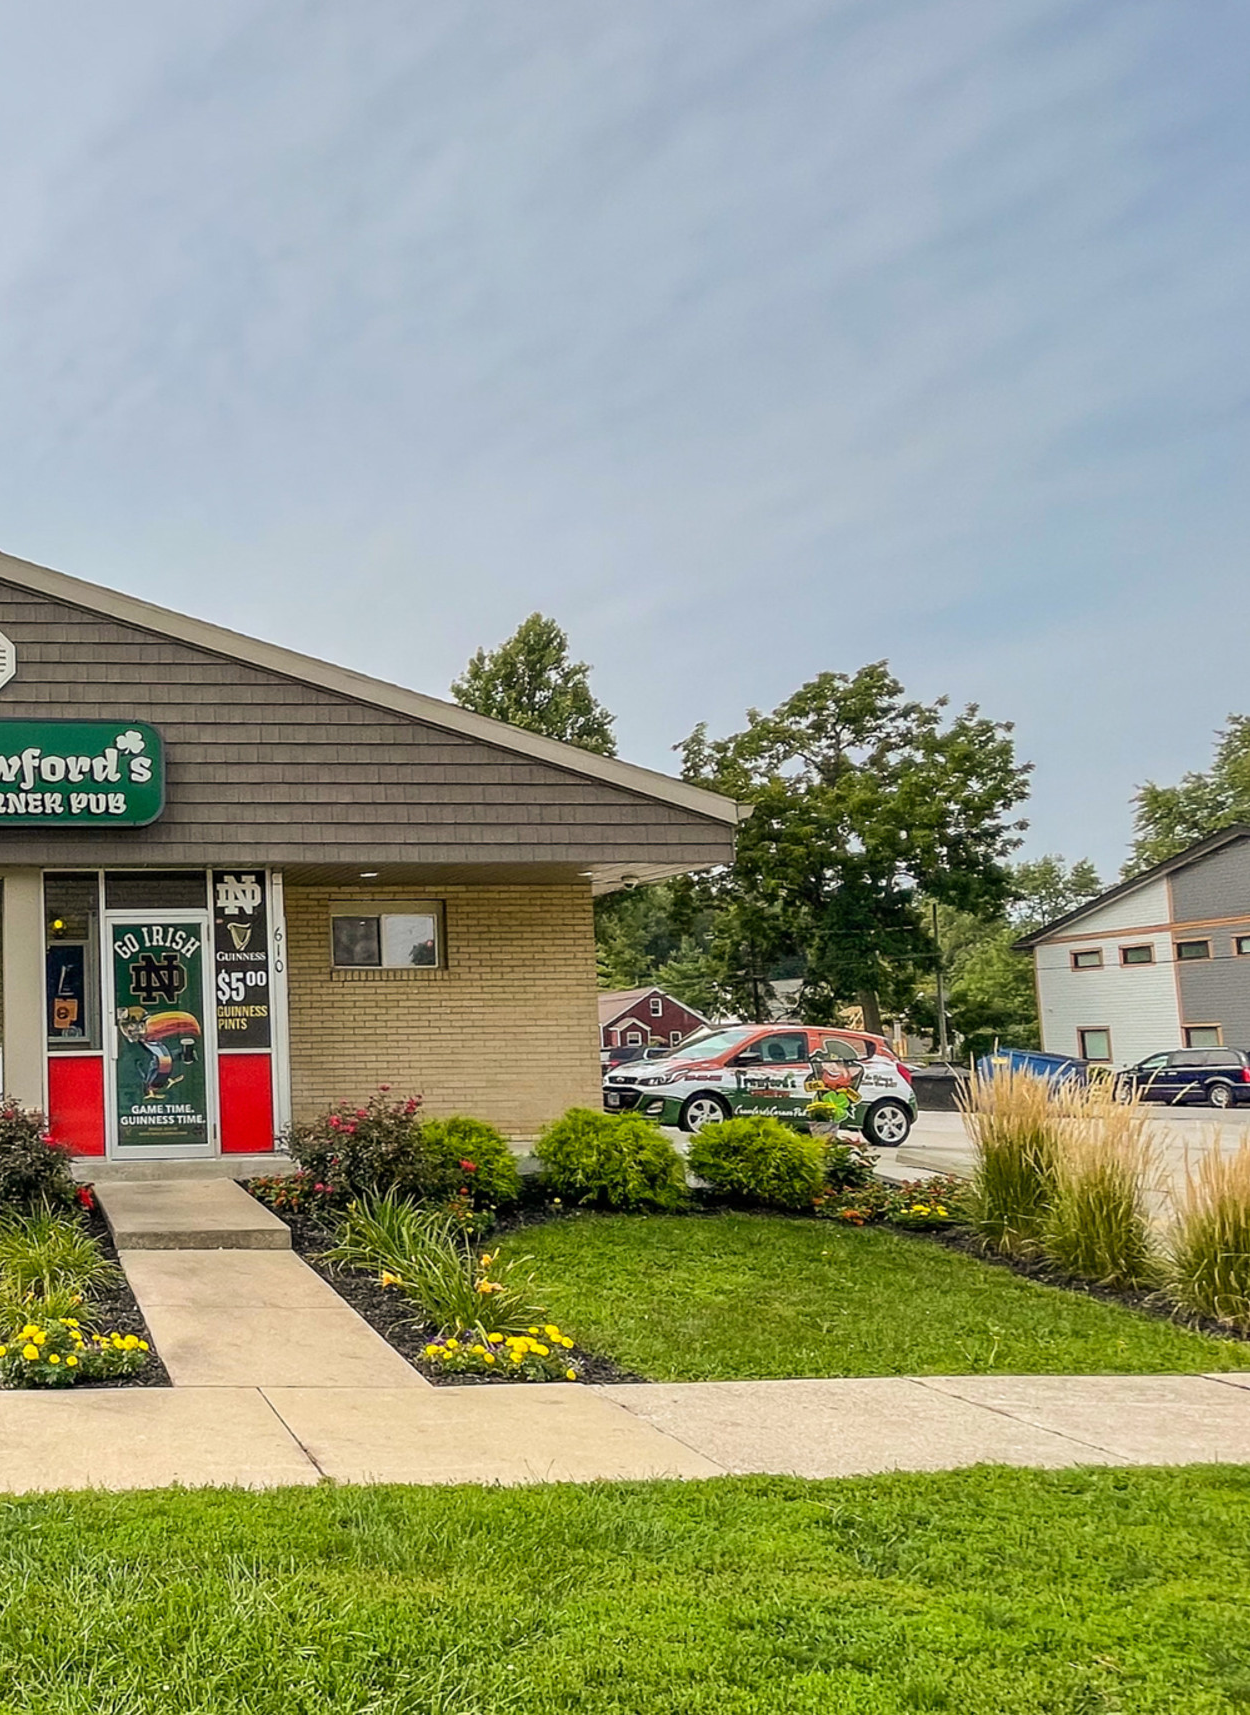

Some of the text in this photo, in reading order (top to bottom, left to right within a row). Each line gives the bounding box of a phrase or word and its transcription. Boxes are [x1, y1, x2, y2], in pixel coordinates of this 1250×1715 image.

[70, 792, 128, 815] PUB
[114, 925, 201, 960] GO IRISH
[216, 951, 267, 962] GUINNESS
[217, 1005, 268, 1018] GUINNESS
[218, 1018, 248, 1030] PINTS
[131, 1104, 195, 1114] GAME TIME.
[120, 1114, 206, 1125] GUINNESS TIME.
